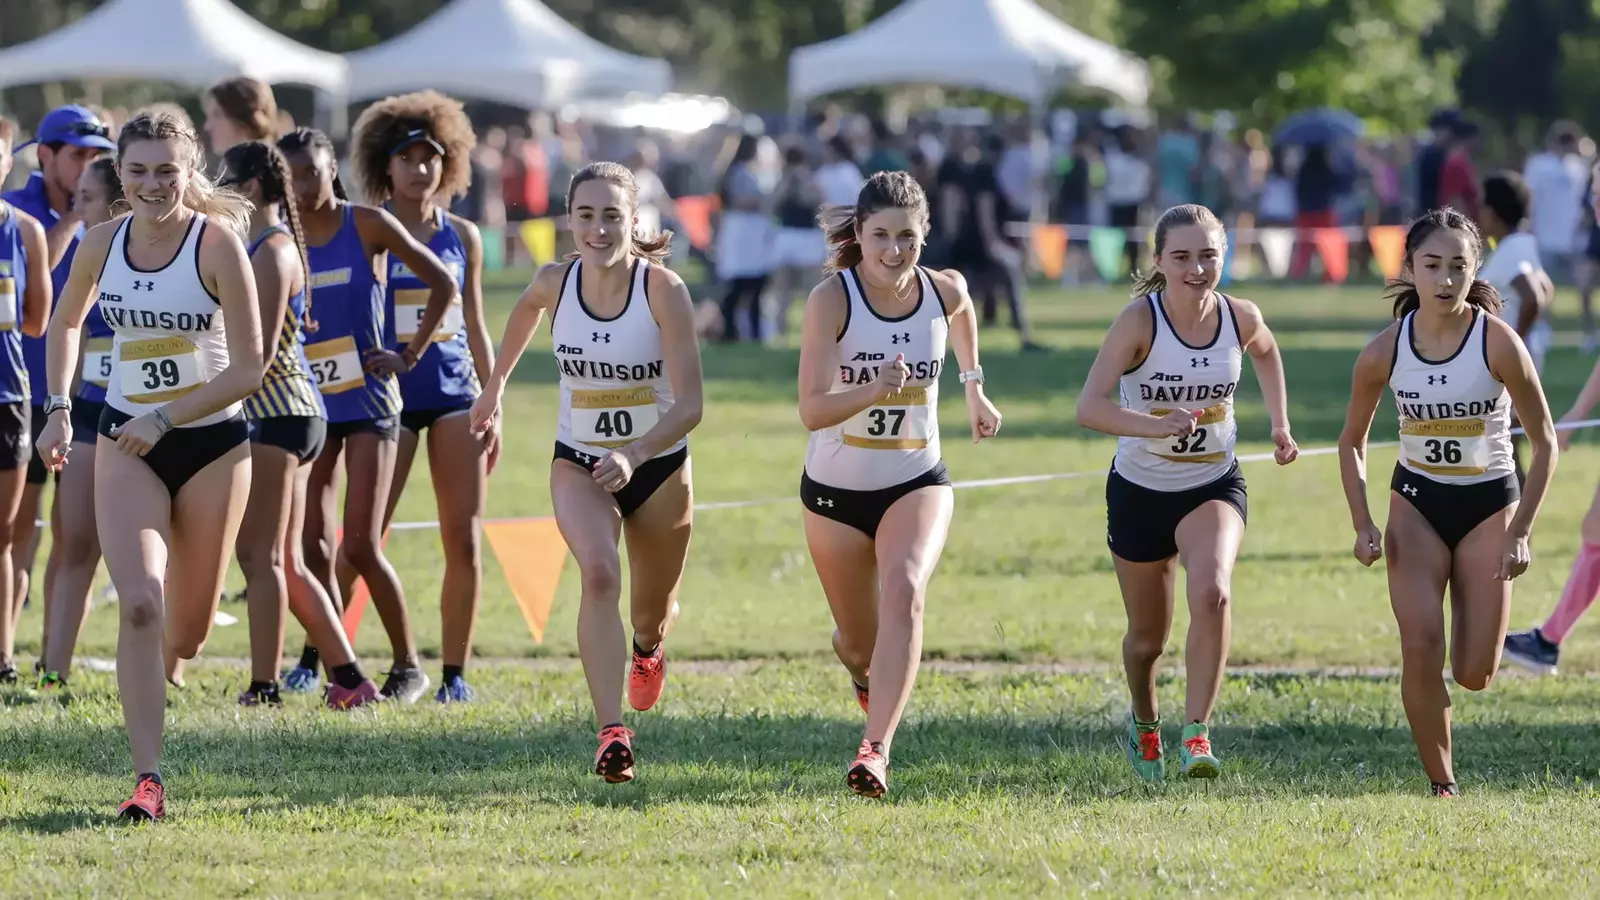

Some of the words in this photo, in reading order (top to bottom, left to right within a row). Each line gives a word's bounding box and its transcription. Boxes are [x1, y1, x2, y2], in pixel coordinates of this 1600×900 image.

[99, 292, 122, 302] A10
[103, 307, 213, 331] AVIDSON
[147, 343, 164, 352] CITY
[557, 344, 583, 355] A10
[851, 352, 885, 361] A10
[142, 359, 180, 389] 39
[312, 360, 340, 384] 52
[1149, 372, 1183, 381] A10
[602, 394, 620, 402] CITY
[902, 391, 925, 399] INVIT
[1140, 382, 1235, 402] DAVIDSO
[1397, 390, 1420, 399] A10
[1400, 398, 1498, 419] AVIDSON
[595, 410, 633, 437] 40
[868, 409, 906, 436] 37
[1403, 422, 1431, 431] QUEEN
[1456, 422, 1485, 431] INVITE
[1171, 428, 1207, 453] 32
[1424, 439, 1462, 464] 36
